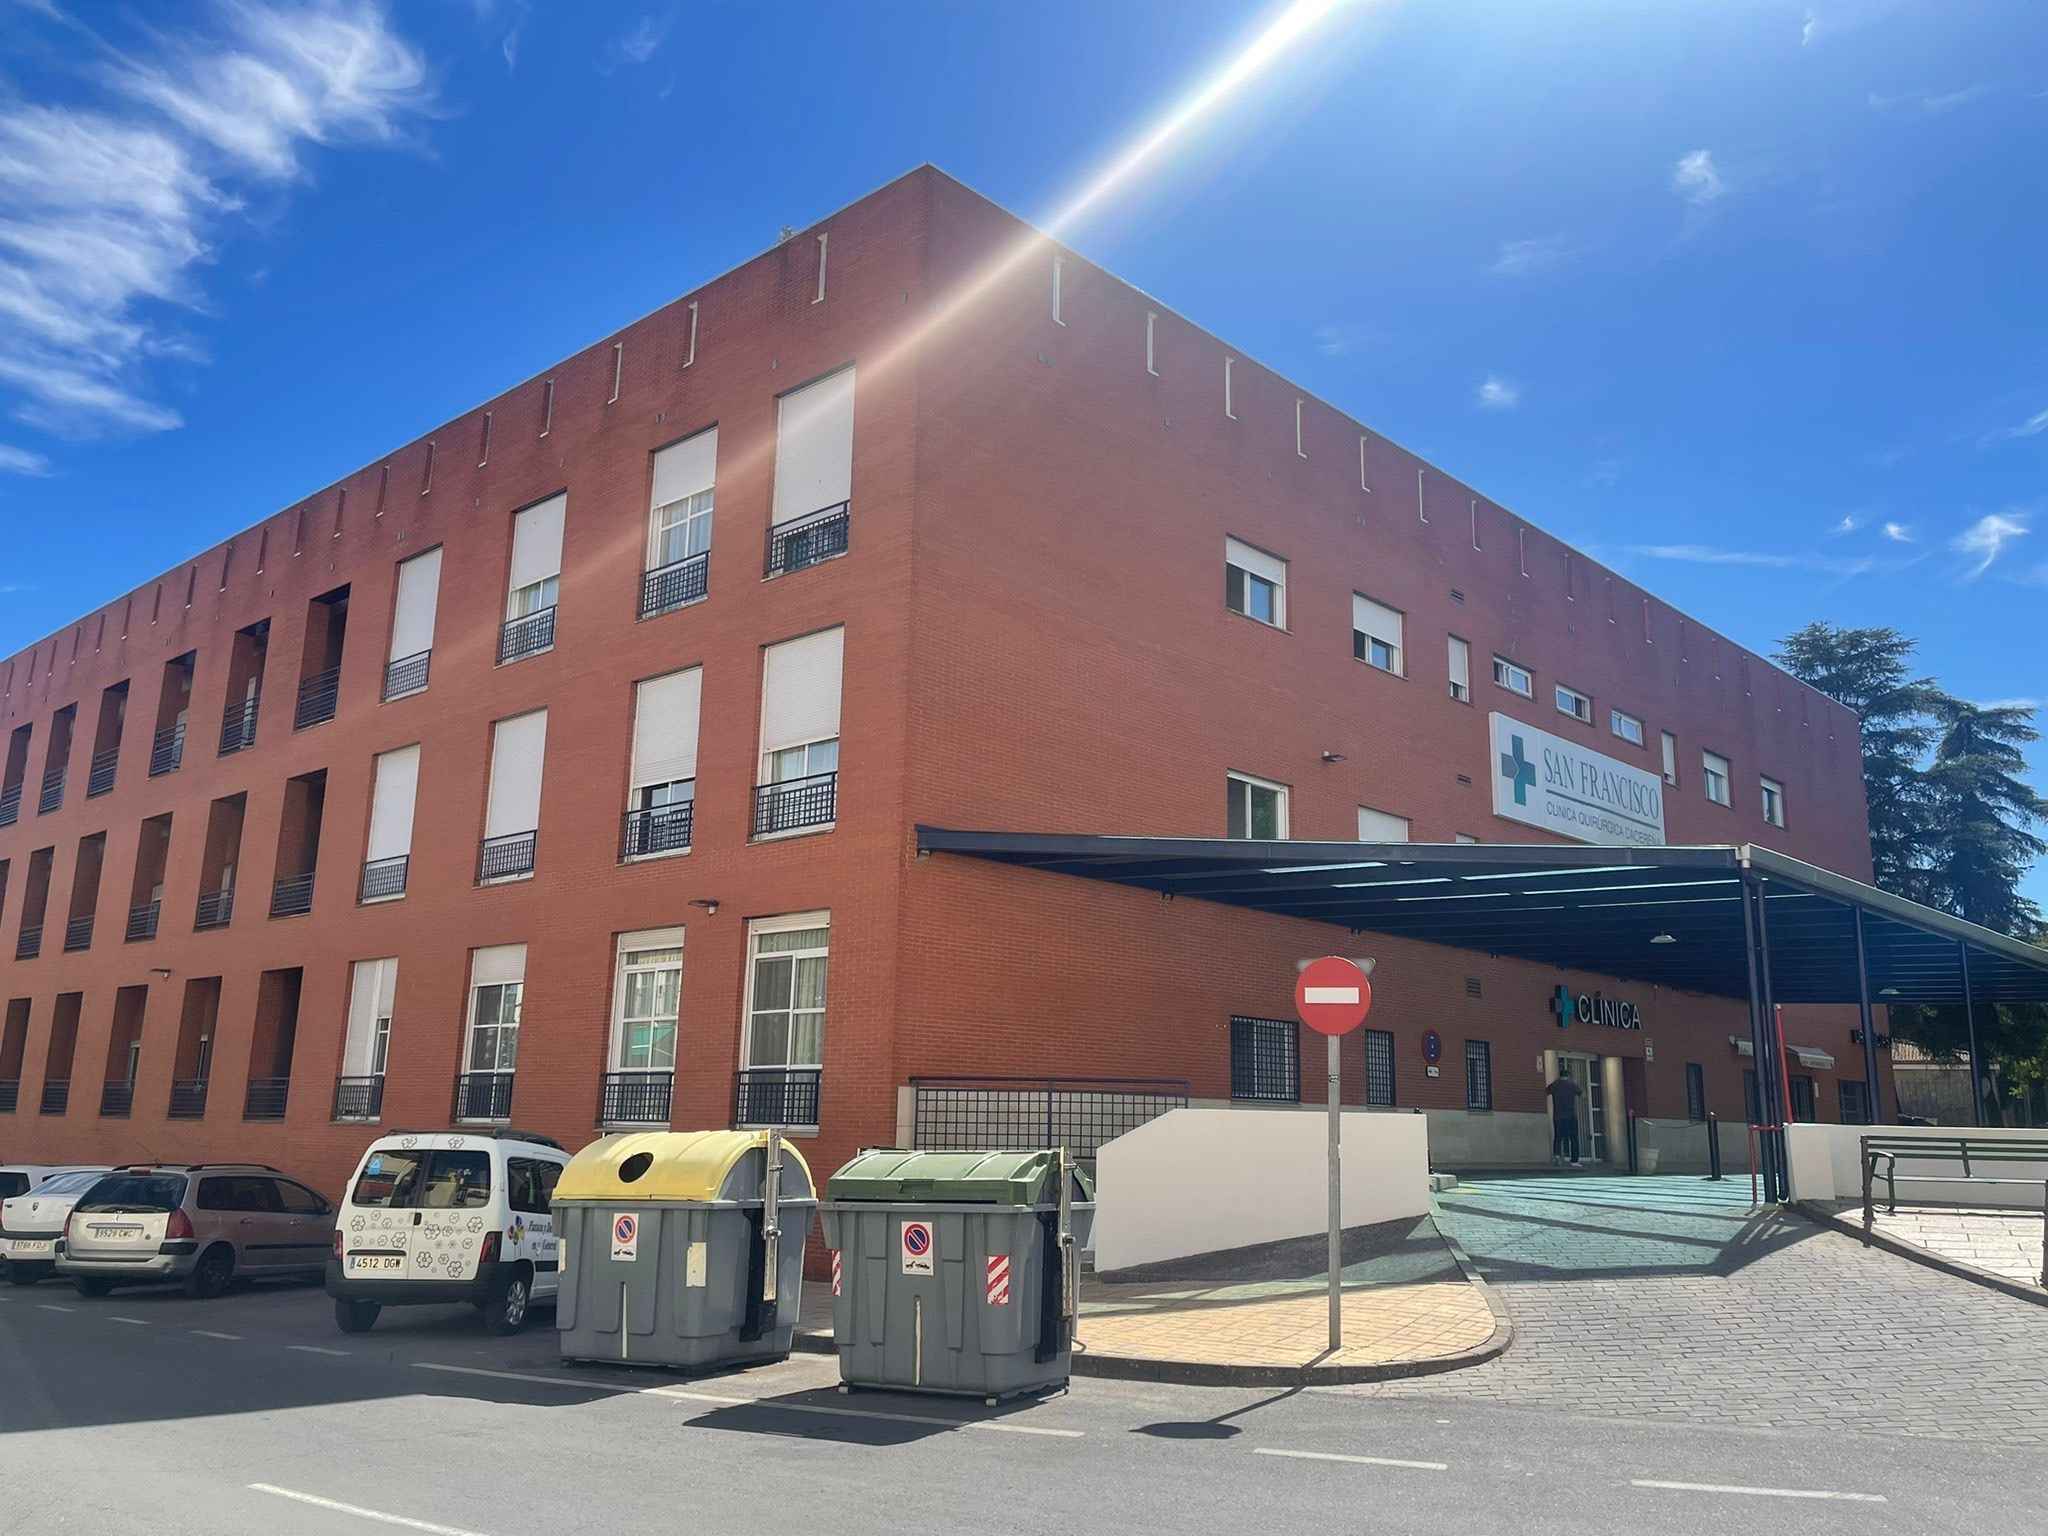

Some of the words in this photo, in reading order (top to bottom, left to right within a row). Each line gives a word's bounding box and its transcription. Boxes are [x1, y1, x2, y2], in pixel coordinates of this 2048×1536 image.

[1543, 747, 1575, 791] SAN
[1580, 760, 1660, 820] FRANCISCO
[356, 1257, 379, 1268] 4512
